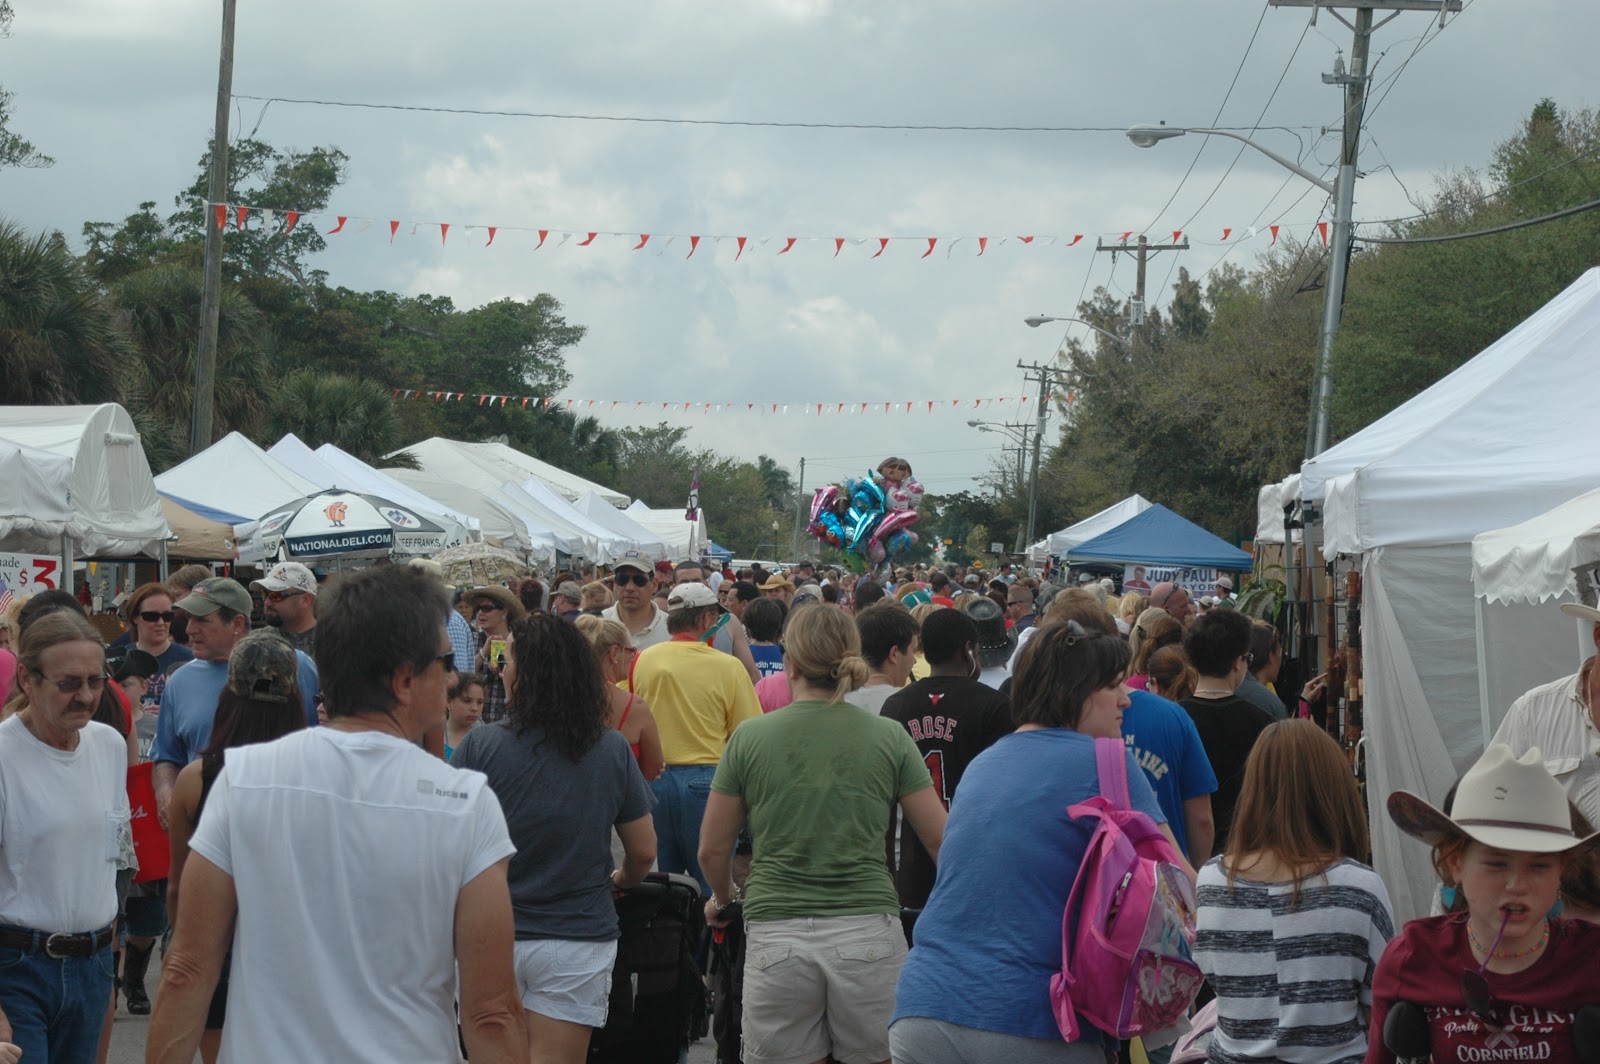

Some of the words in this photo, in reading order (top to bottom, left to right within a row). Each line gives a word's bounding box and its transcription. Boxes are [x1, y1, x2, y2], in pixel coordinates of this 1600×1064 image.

[291, 534, 391, 552] NATIONALDELI.COM
[399, 538, 412, 547] EEF
[413, 538, 441, 547] FRANKS
[0, 556, 19, 568] ade
[1146, 569, 1180, 583] JUDY
[1182, 569, 1215, 582] PAUL
[908, 715, 957, 742] ROSE
[1444, 1019, 1479, 1038] Party
[1456, 1040, 1551, 1063] CORNFIELD
